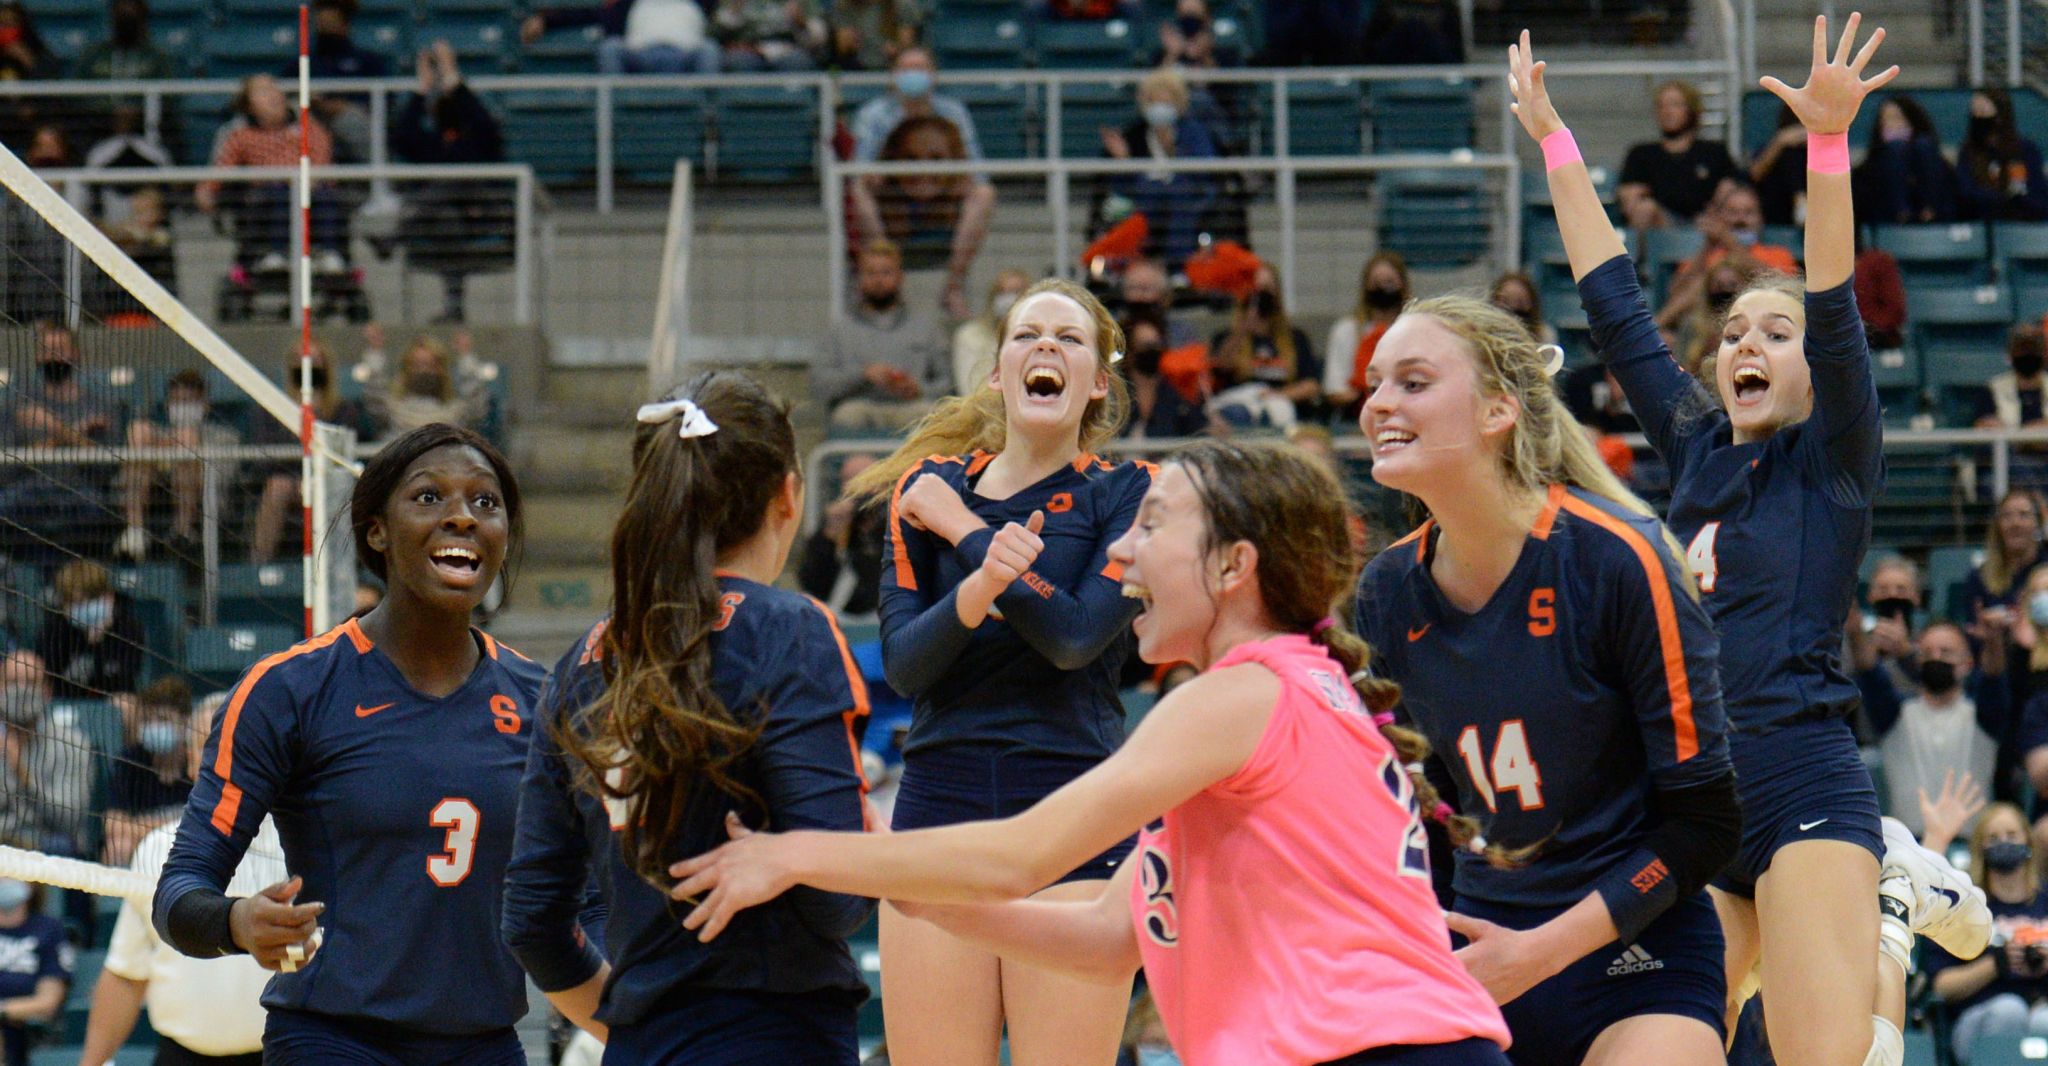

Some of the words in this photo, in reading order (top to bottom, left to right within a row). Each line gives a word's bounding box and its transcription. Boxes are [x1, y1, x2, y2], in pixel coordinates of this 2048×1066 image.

[1685, 521, 1721, 592] 4
[1528, 587, 1557, 637] S
[490, 694, 522, 734] S
[1457, 719, 1545, 813] 14
[426, 797, 481, 887] 3
[1606, 960, 1664, 976] adidas
